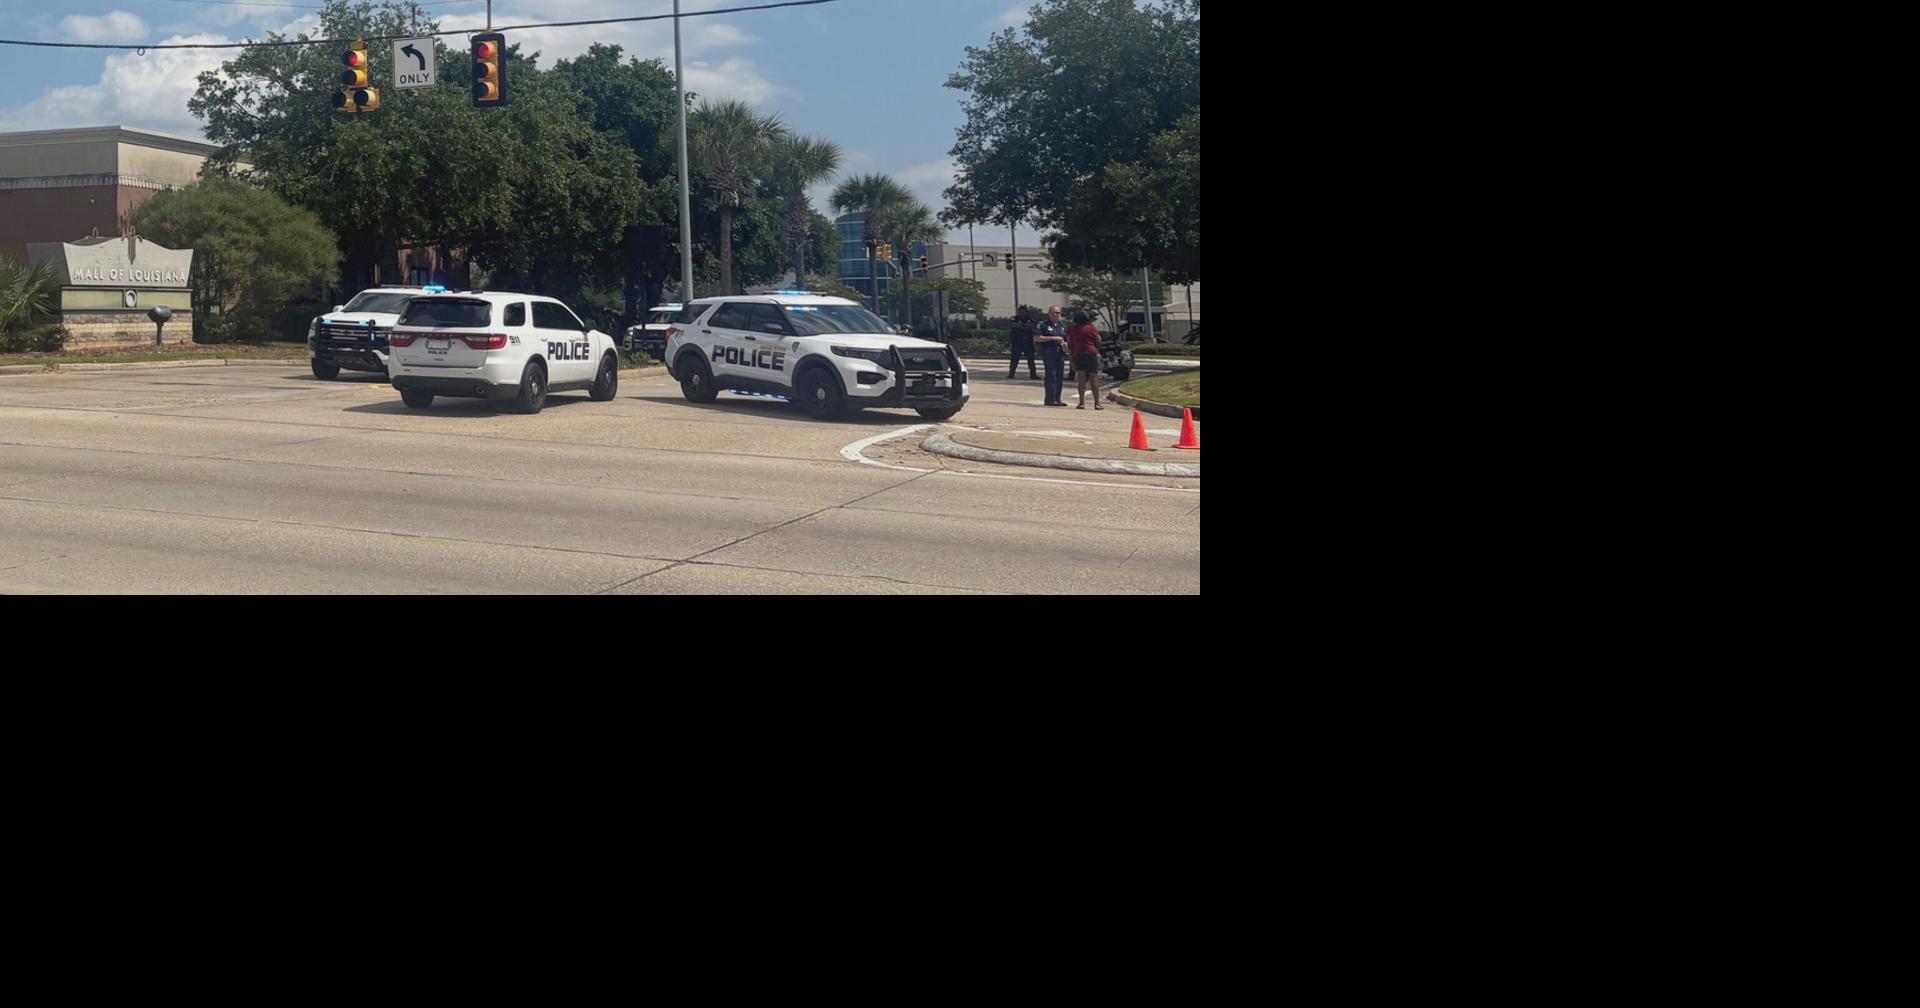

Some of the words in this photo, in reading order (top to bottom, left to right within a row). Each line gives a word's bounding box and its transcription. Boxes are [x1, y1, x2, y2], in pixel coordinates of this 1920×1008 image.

[400, 73, 429, 84] ONLY
[74, 267, 104, 280] MALL
[110, 268, 124, 280] OF
[129, 269, 186, 282] LOUISIANA
[547, 341, 590, 360] POLICE
[711, 344, 786, 371] POLICE
